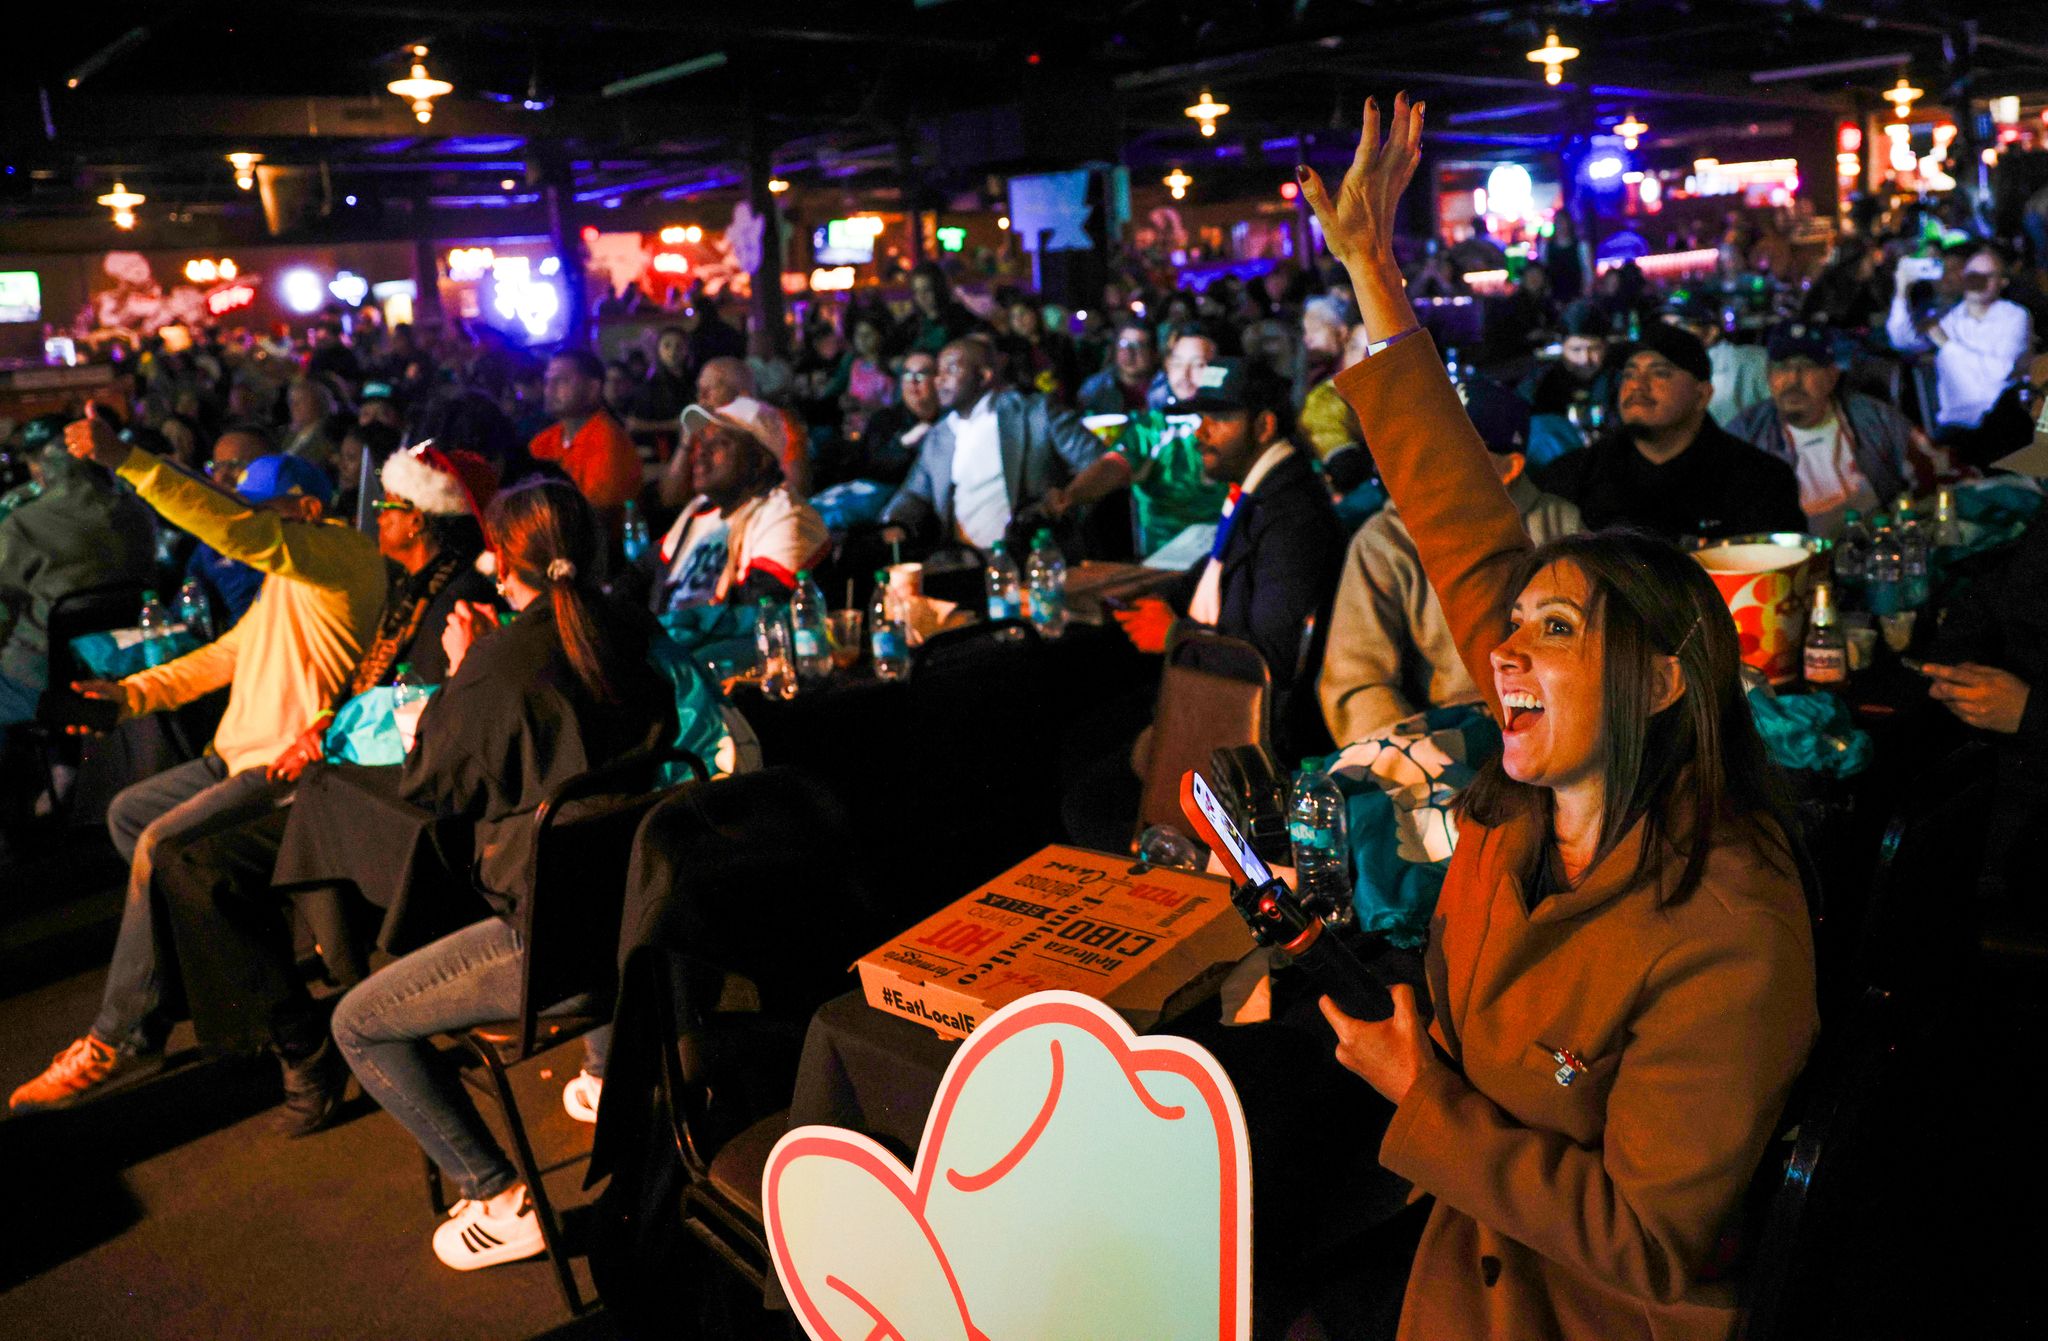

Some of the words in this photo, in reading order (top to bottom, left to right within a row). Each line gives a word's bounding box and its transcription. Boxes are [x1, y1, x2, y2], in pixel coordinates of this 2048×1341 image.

[989, 895, 1043, 917] BELLA
[1128, 883, 1189, 908] PIZZA
[917, 920, 1004, 957] HOT
[1057, 920, 1156, 956] CIBO
[883, 951, 964, 979] formaggio
[1044, 941, 1123, 972] Bellezza
